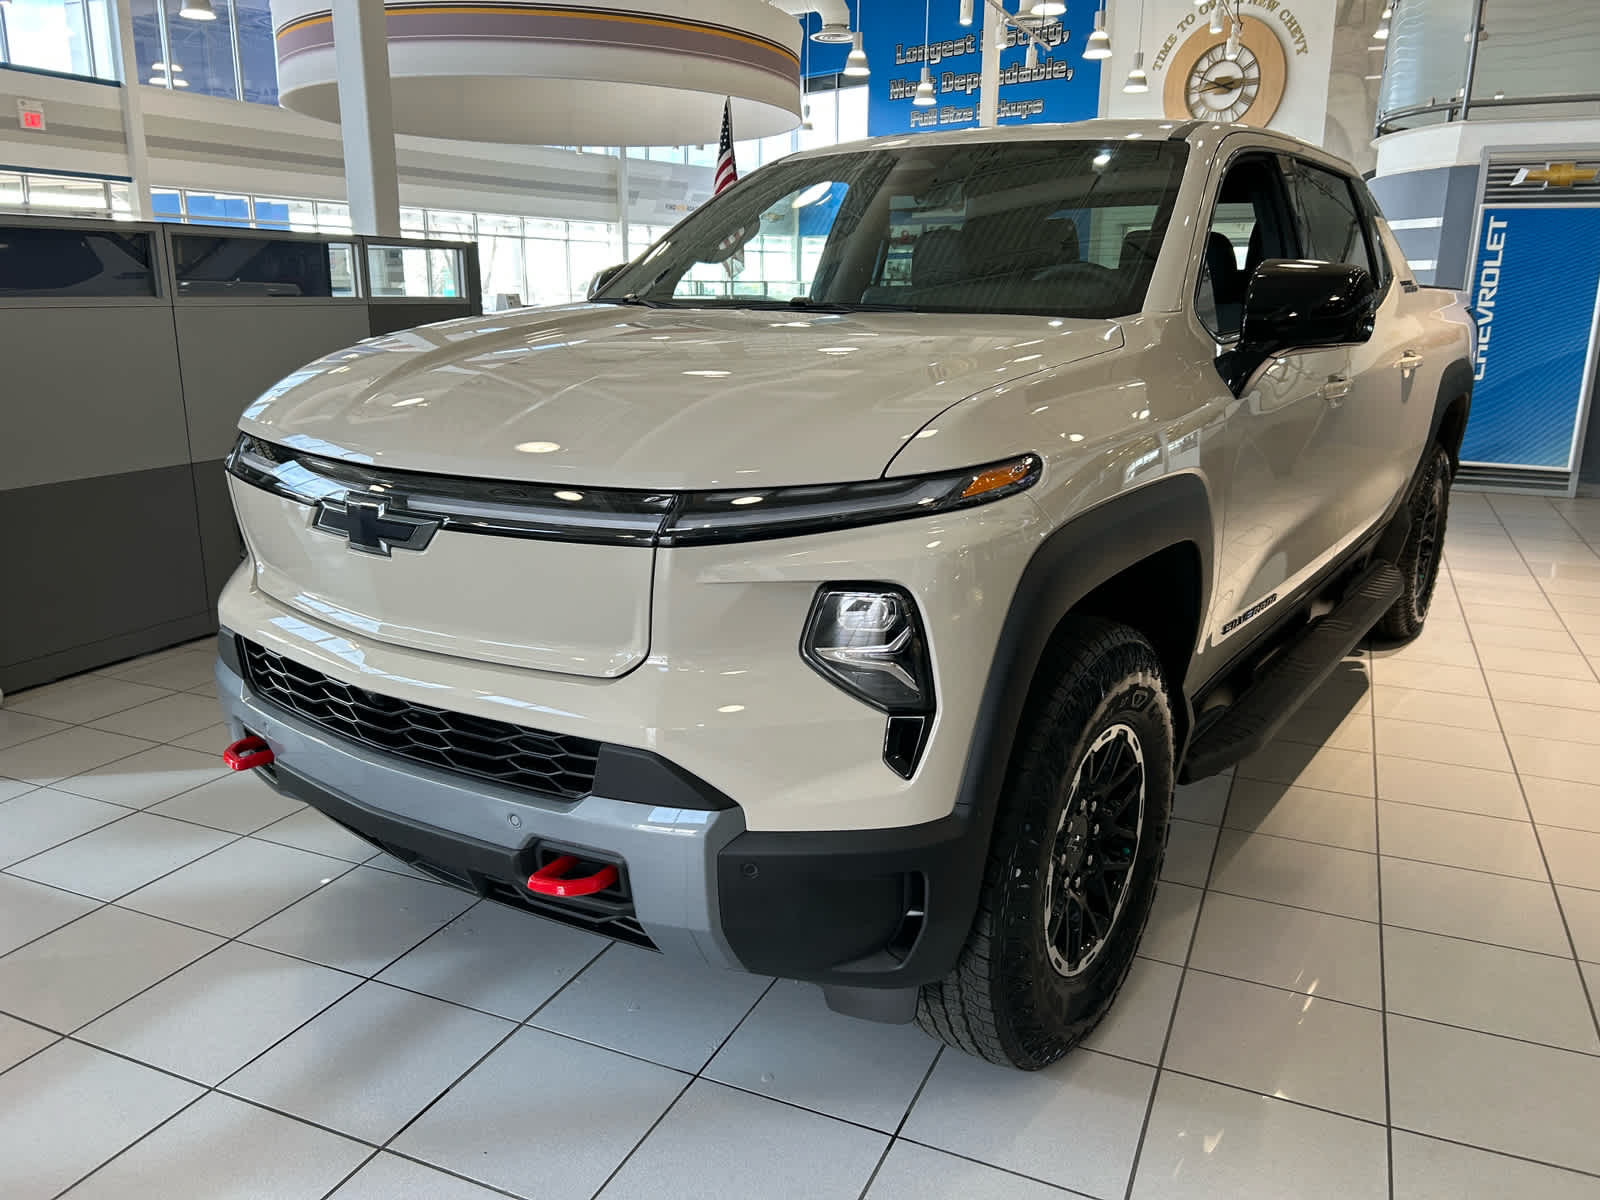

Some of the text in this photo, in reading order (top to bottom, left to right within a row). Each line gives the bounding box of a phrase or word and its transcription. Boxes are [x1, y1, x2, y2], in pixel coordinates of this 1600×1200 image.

[895, 34, 976, 64] Longest
[1153, 33, 1178, 71] TIME
[1177, 14, 1196, 32] TO
[1279, 9, 1309, 55] CHEVY
[910, 108, 937, 128] Full
[940, 105, 973, 125] Size
